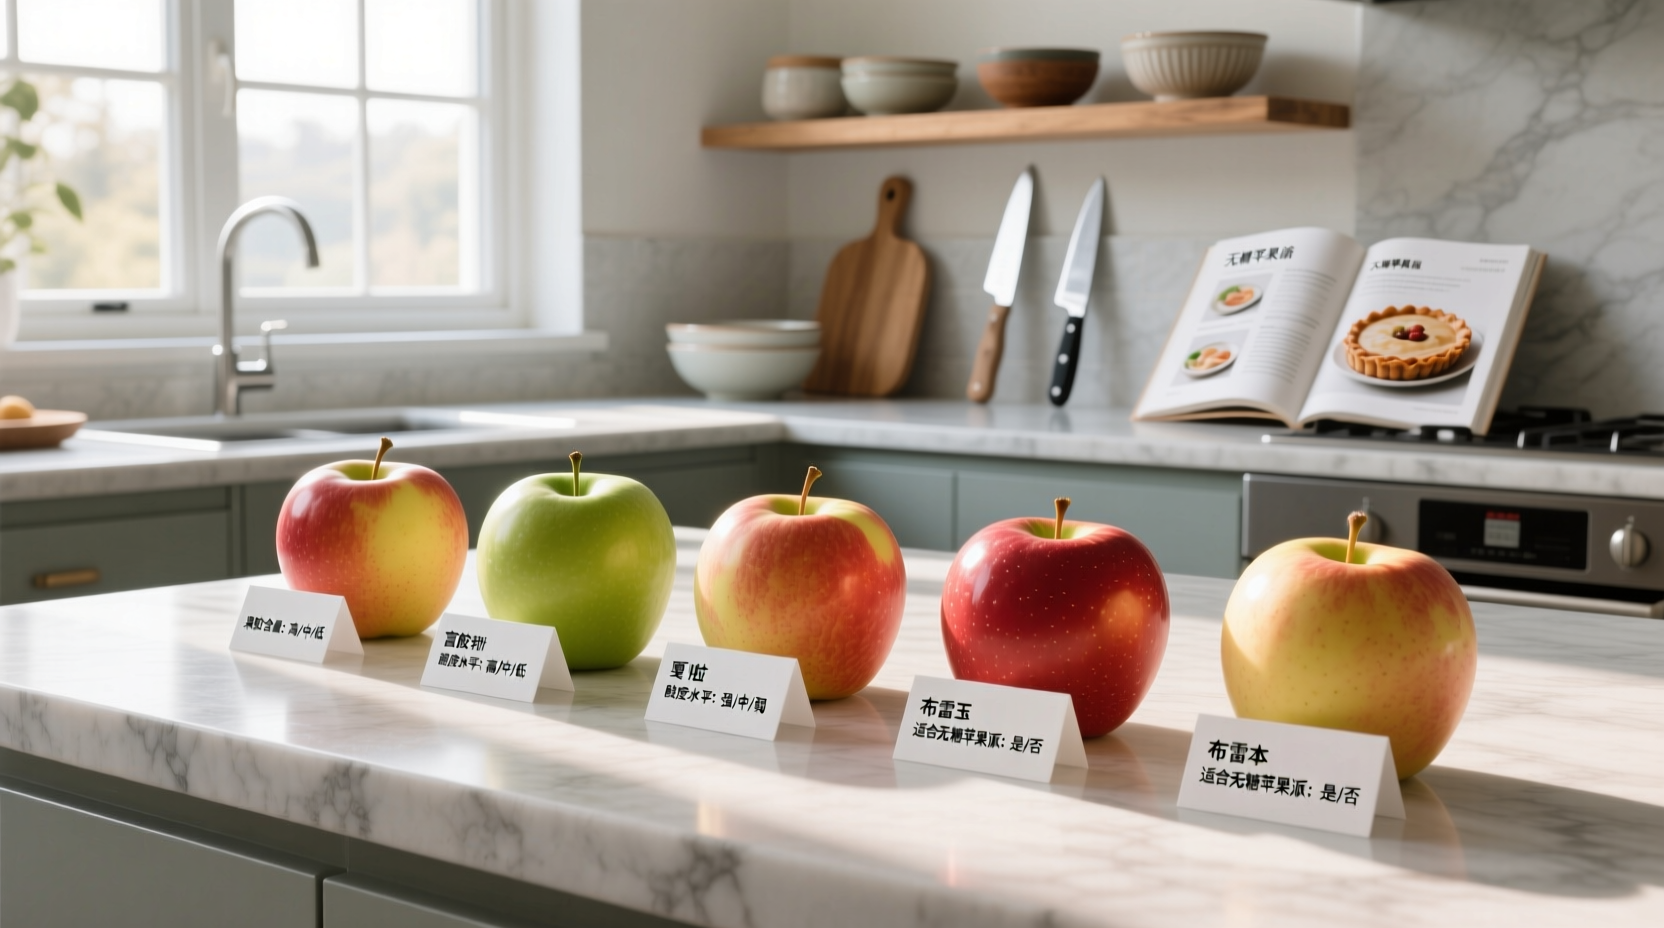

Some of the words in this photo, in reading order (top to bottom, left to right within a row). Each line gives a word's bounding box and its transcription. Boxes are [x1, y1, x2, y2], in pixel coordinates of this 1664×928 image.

[919, 697, 973, 720] 布雷玉
[1207, 739, 1269, 766] 布雷本
